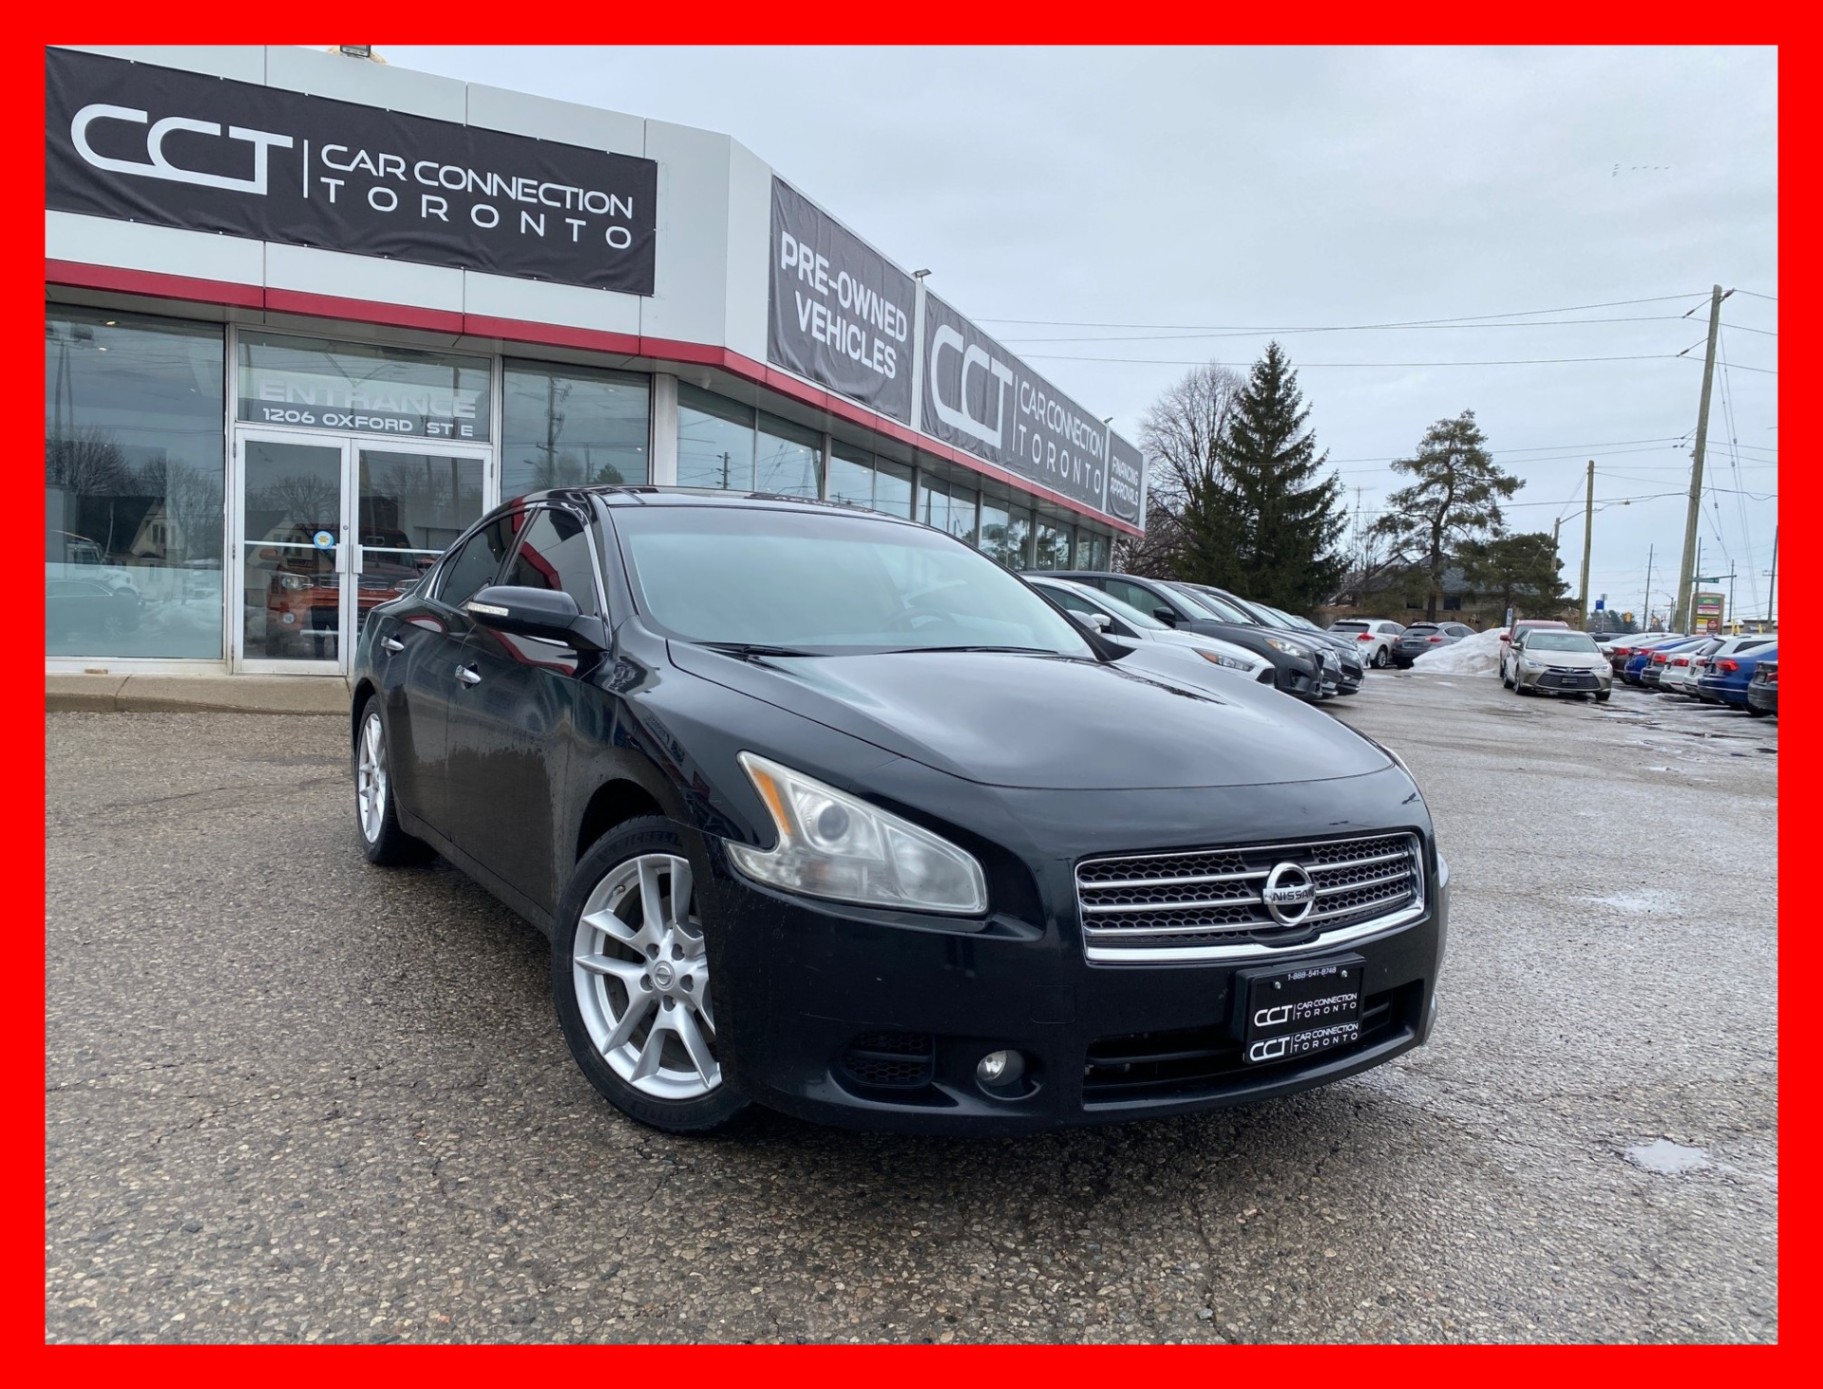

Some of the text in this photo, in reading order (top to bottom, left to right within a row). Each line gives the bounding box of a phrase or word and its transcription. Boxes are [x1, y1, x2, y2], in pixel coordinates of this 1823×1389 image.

[71, 103, 293, 195] CCT
[320, 143, 633, 219] CAR CONNECTION
[320, 177, 633, 250] TORONTO
[781, 231, 907, 342] PRE-OWNED
[795, 291, 897, 379] VEHICLES
[259, 380, 476, 418] ENTRANCE
[931, 324, 1013, 449] CCT
[263, 408, 474, 437] 1206 OXFORD ST E
[1020, 381, 1104, 461] CAR CONNECTION
[1017, 424, 1101, 495] TORONTO
[1271, 885, 1315, 901] NISSAN
[1254, 1004, 1293, 1027] CCT
[1296, 992, 1358, 1010] CAR CONNECTION
[1296, 1001, 1357, 1020] TORONTO
[1250, 1036, 1291, 1061] CCT
[1294, 1023, 1359, 1042] CAR CONNECTION
[1294, 1032, 1358, 1053] TORONTO
